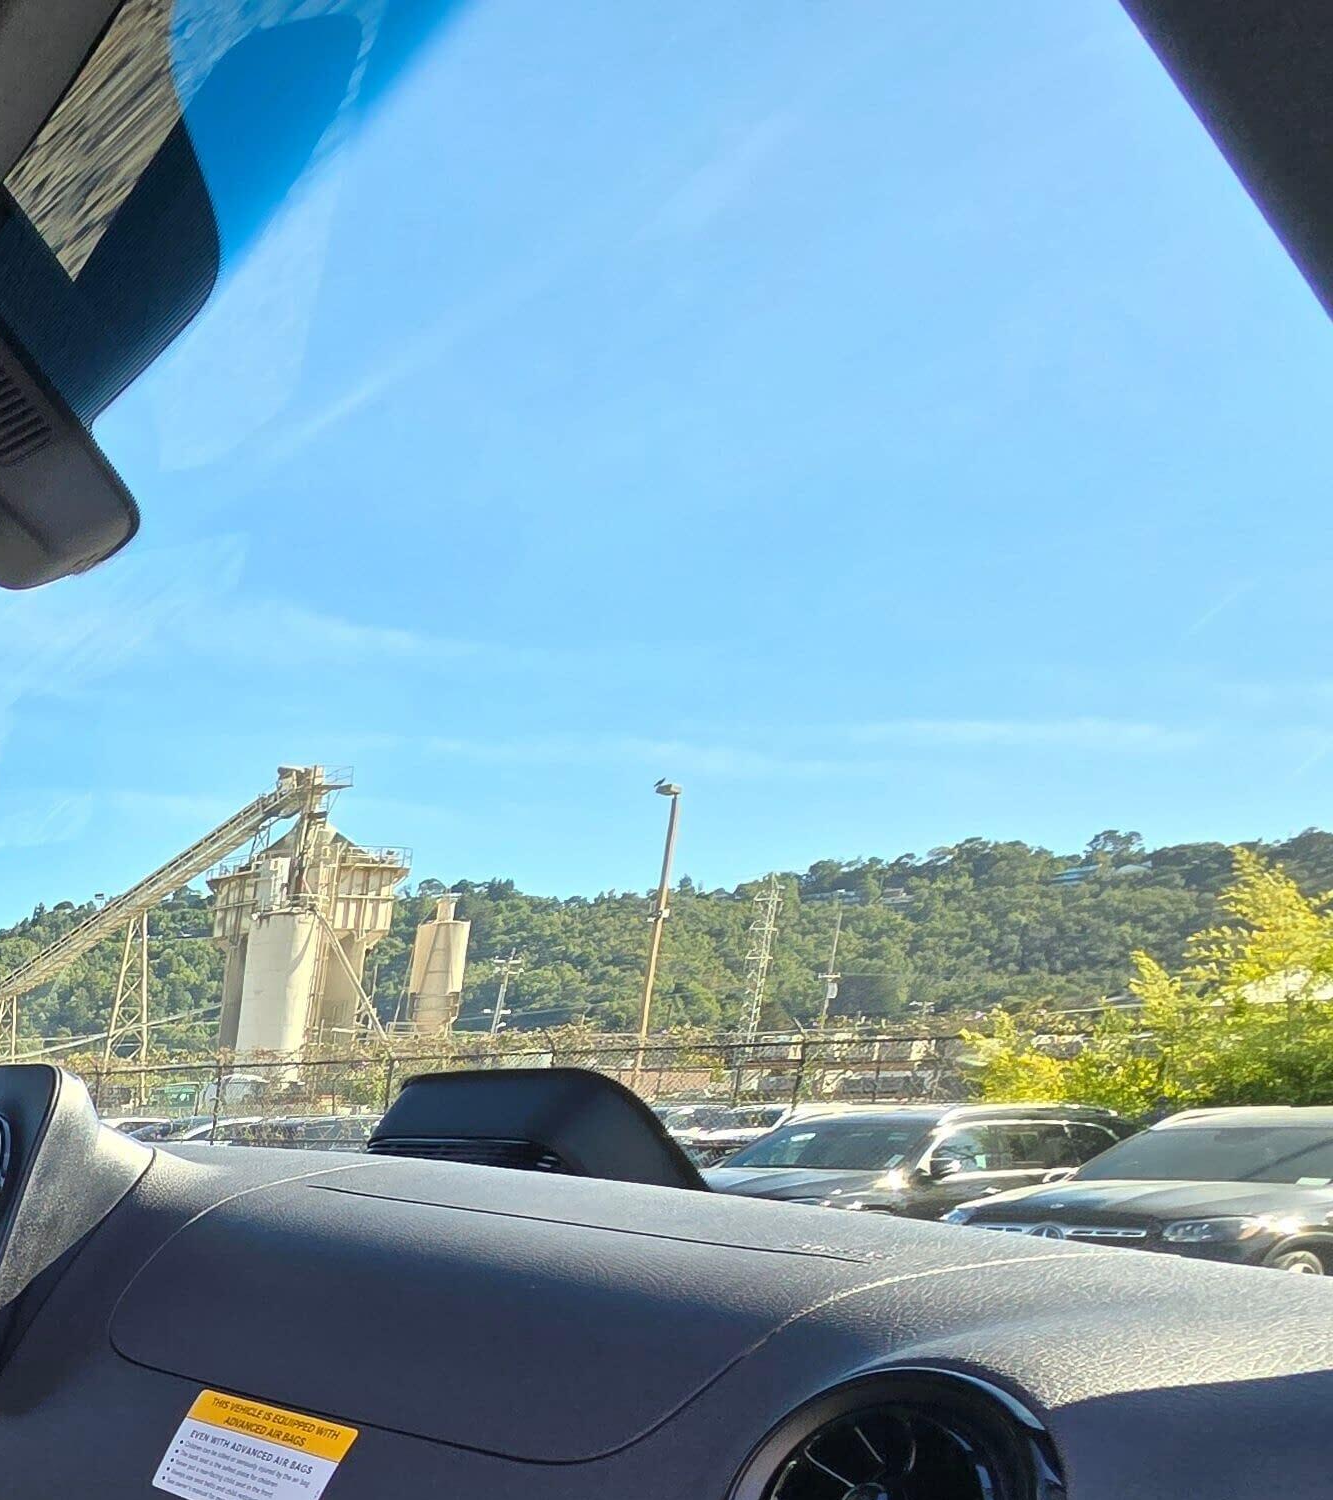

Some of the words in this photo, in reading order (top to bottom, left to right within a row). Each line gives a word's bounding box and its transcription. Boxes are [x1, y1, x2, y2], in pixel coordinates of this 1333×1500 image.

[212, 1397, 230, 1409] THIS
[230, 1403, 263, 1418] VEHICLE
[272, 1414, 315, 1432] EQUIPPED
[315, 1426, 340, 1439] WITH
[223, 1417, 266, 1434] ADVANCED
[266, 1428, 282, 1439] AIR
[281, 1432, 306, 1446] BAGS
[190, 1430, 210, 1441] EVEN
[210, 1437, 230, 1447] WITH
[230, 1443, 273, 1461] ADVANCED
[273, 1456, 289, 1467] AIR
[289, 1461, 312, 1474] BAGS
